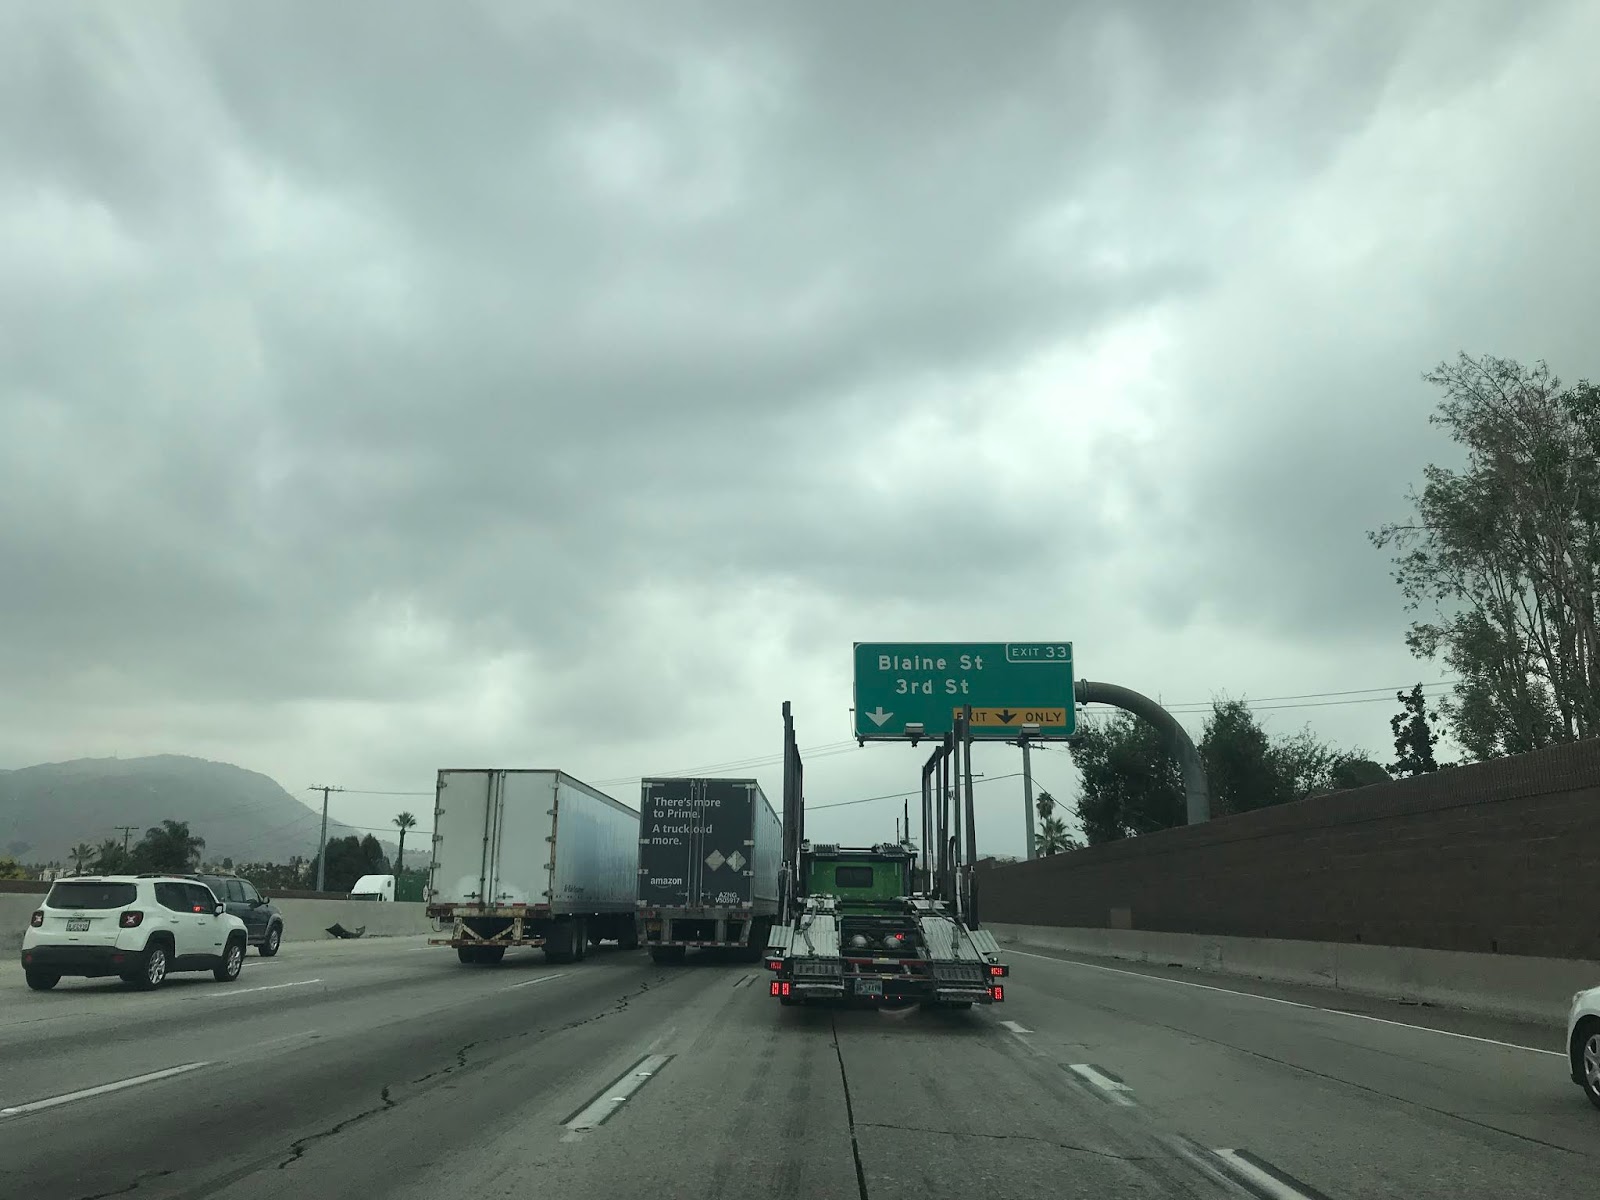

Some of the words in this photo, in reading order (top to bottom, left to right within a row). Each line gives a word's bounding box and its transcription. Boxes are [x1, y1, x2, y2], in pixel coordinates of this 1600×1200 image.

[1012, 648, 1039, 656] EXIT
[1045, 646, 1067, 658] 33
[878, 655, 947, 671] Blaine
[959, 655, 983, 671] St
[896, 678, 933, 695] 3rd
[945, 678, 969, 695] St
[1025, 712, 1062, 722] ONLY
[654, 796, 692, 807] There's
[694, 799, 721, 807] more
[653, 808, 665, 818] to
[667, 808, 701, 819] Prime.
[652, 823, 660, 833] A
[663, 823, 713, 834] truckoad
[652, 837, 682, 845] more.
[650, 877, 682, 885] amazon
